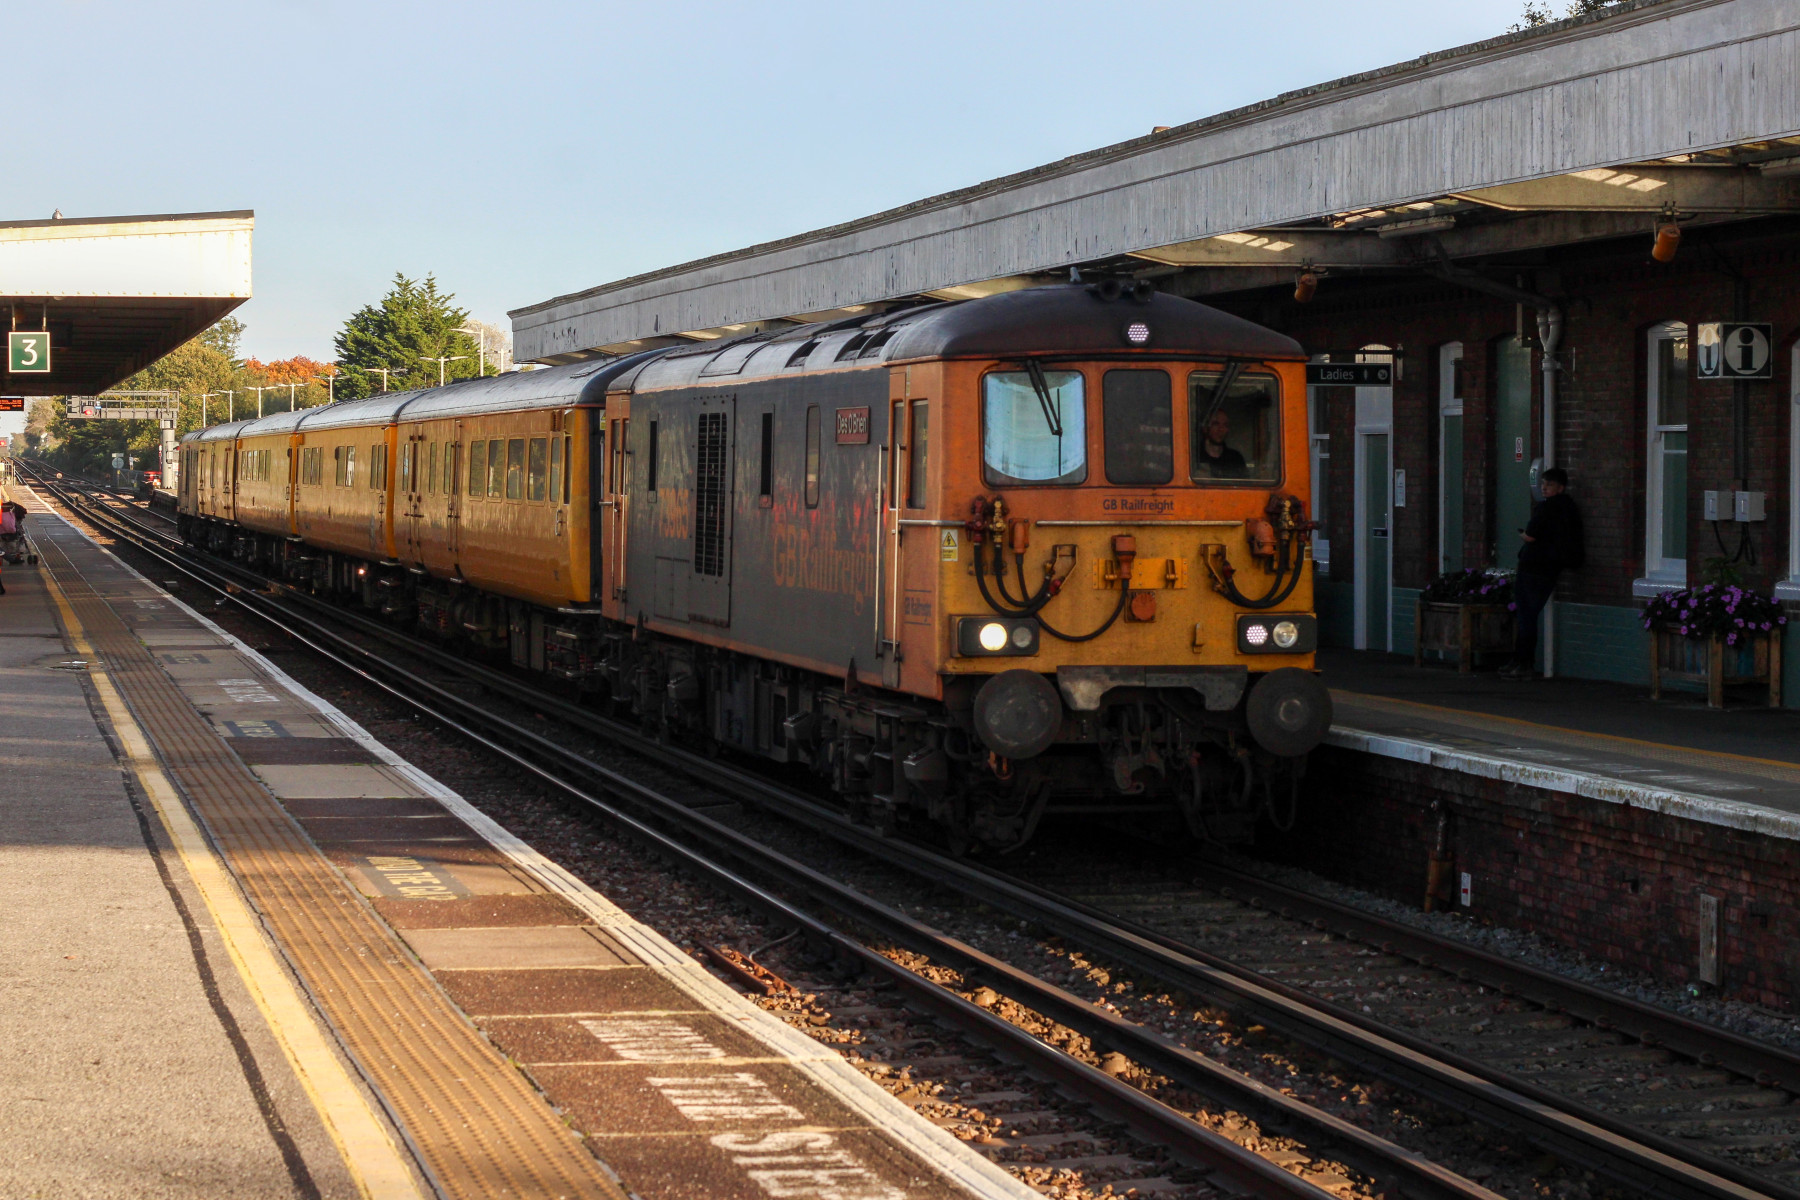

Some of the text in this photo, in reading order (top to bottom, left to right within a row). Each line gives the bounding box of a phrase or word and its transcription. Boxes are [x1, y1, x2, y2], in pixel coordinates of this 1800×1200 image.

[21, 339, 38, 366] 3
[1320, 368, 1355, 381] Ladies
[837, 413, 848, 434] Des
[1103, 498, 1174, 514] GB Railfreight
[774, 523, 881, 617] GB Railfreigh
[383, 871, 442, 885] THE
[397, 886, 458, 900] GAP
[645, 1071, 806, 1122] THE
